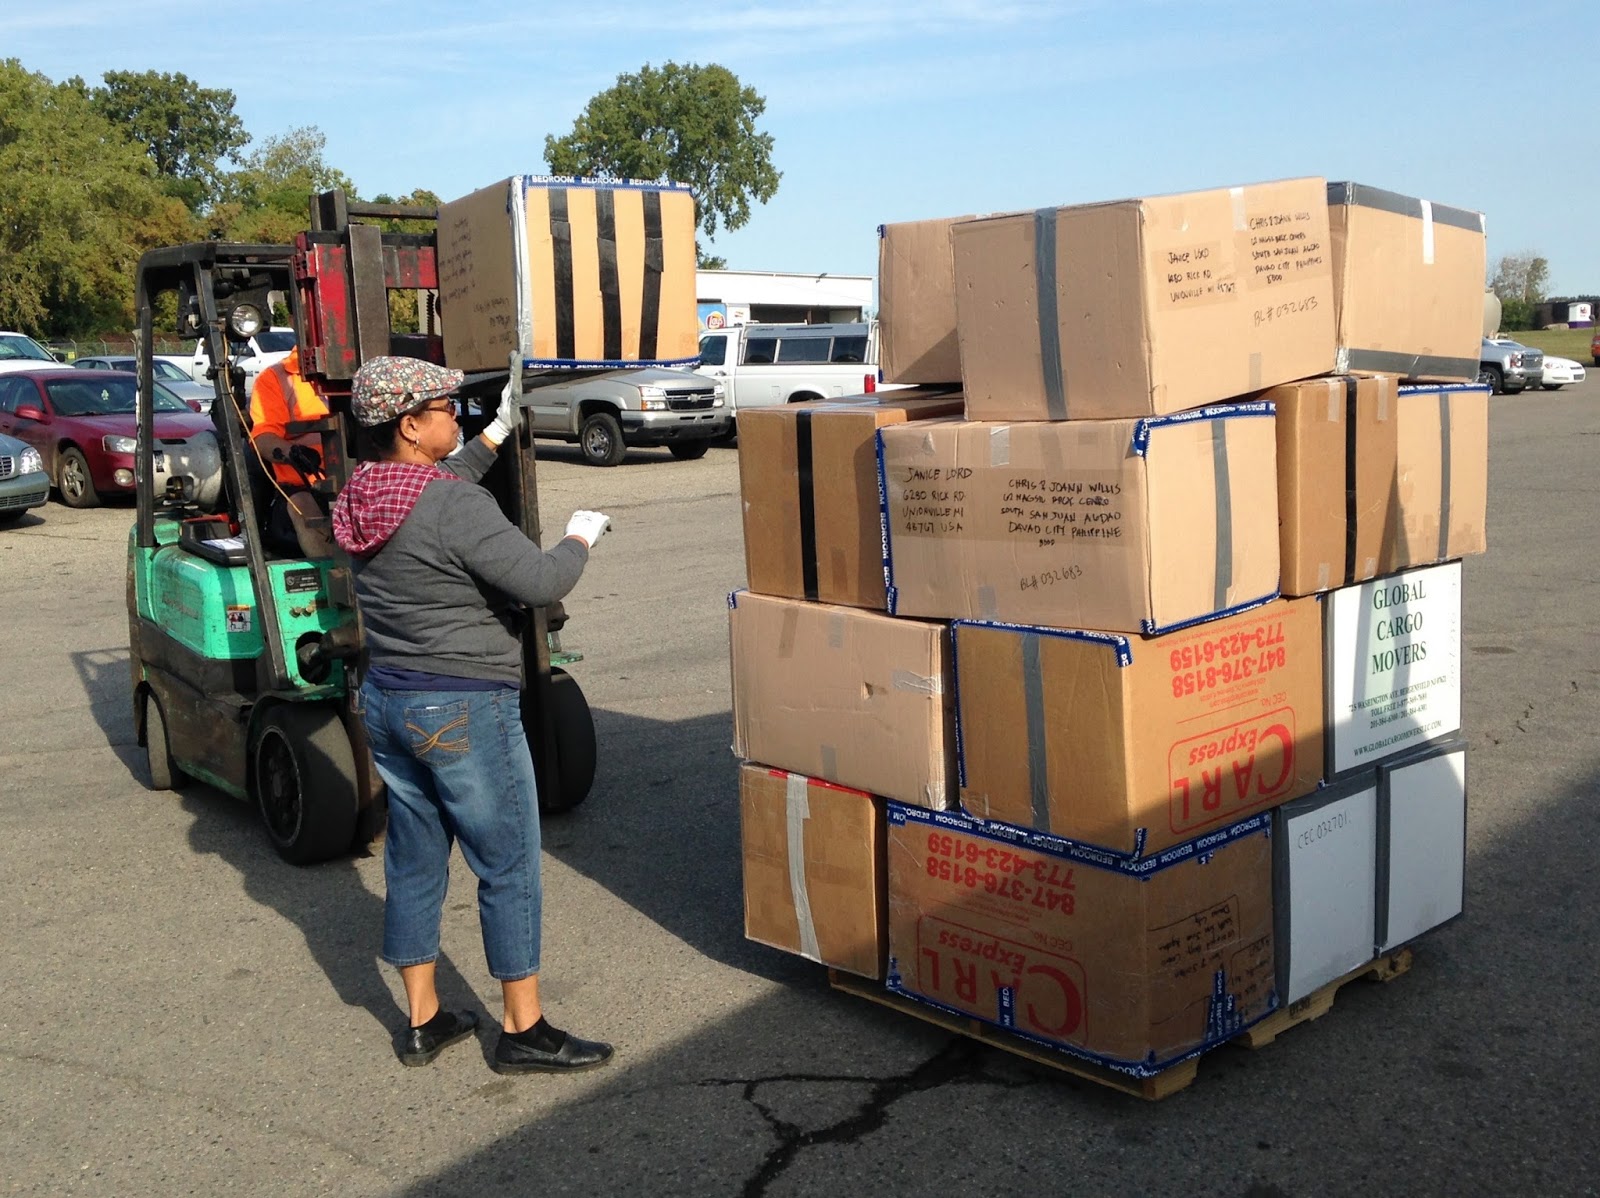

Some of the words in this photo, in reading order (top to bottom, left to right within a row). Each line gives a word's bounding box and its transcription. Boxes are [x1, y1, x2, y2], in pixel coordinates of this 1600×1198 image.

[532, 175, 575, 183] BEDROOM
[629, 178, 670, 187] BEDROOM
[903, 467, 940, 482] JANICE
[946, 467, 972, 481] LORD
[1009, 479, 1037, 490] CHRIS
[1049, 481, 1083, 494] JOANN
[1089, 482, 1121, 495] WILLIS
[902, 506, 951, 519] UNIONVILLE
[1000, 507, 1024, 516] SOUTH
[1029, 510, 1048, 520] SAN
[1051, 512, 1076, 523] JUAN
[880, 512, 889, 559] BEDROOM
[940, 521, 963, 532] USA
[1008, 521, 1040, 534] DAVAO
[1045, 525, 1065, 536] CITY
[1373, 579, 1427, 610] GLOBAL
[1377, 611, 1423, 641] CARGO
[1170, 622, 1285, 672] 773-423-6159
[1372, 641, 1428, 675] MOVERS
[1171, 646, 1286, 698] 847-376-8158
[1188, 727, 1259, 766] Express
[1174, 723, 1293, 820] CARL
[935, 814, 973, 830] BEDROOM
[978, 824, 1017, 841] BEDROOM
[1230, 817, 1261, 836] BEDROOM
[1023, 835, 1064, 853] BEDROOM
[1297, 828, 1315, 850] CEC
[927, 832, 1077, 891] 773-423-6159
[1161, 843, 1193, 864] BEDROOM
[925, 856, 1075, 916] 847-376-8158
[938, 929, 1026, 977] Express
